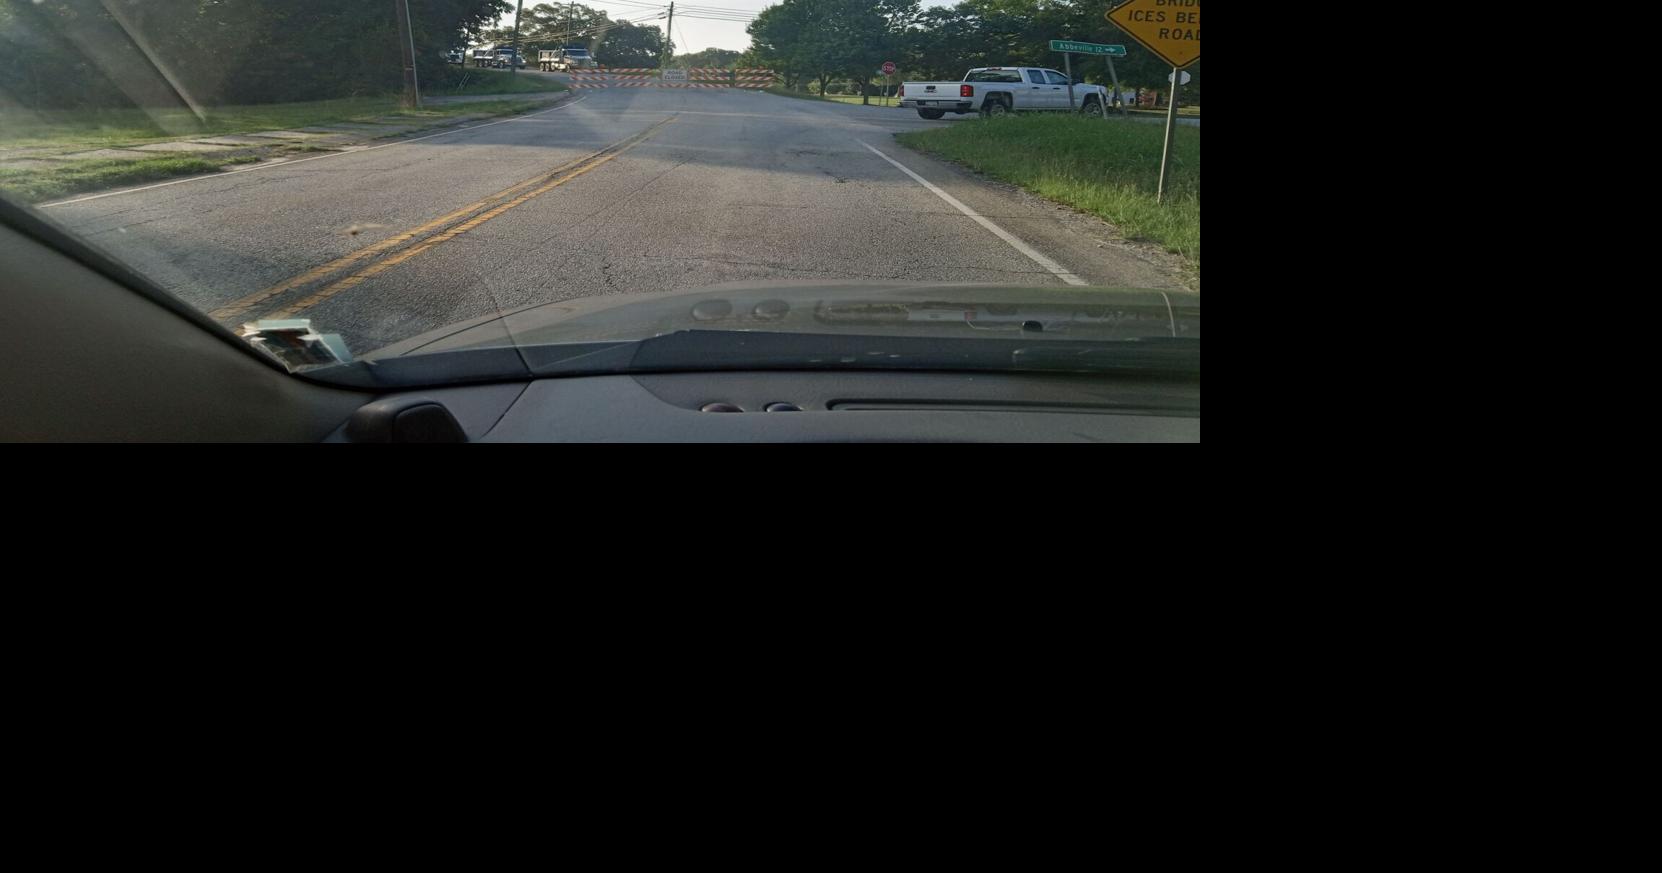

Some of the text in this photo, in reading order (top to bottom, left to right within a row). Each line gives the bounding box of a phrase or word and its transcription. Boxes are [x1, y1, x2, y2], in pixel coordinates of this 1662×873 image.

[1128, 10, 1200, 24] ICES BE
[1059, 43, 1093, 52] Abbeville
